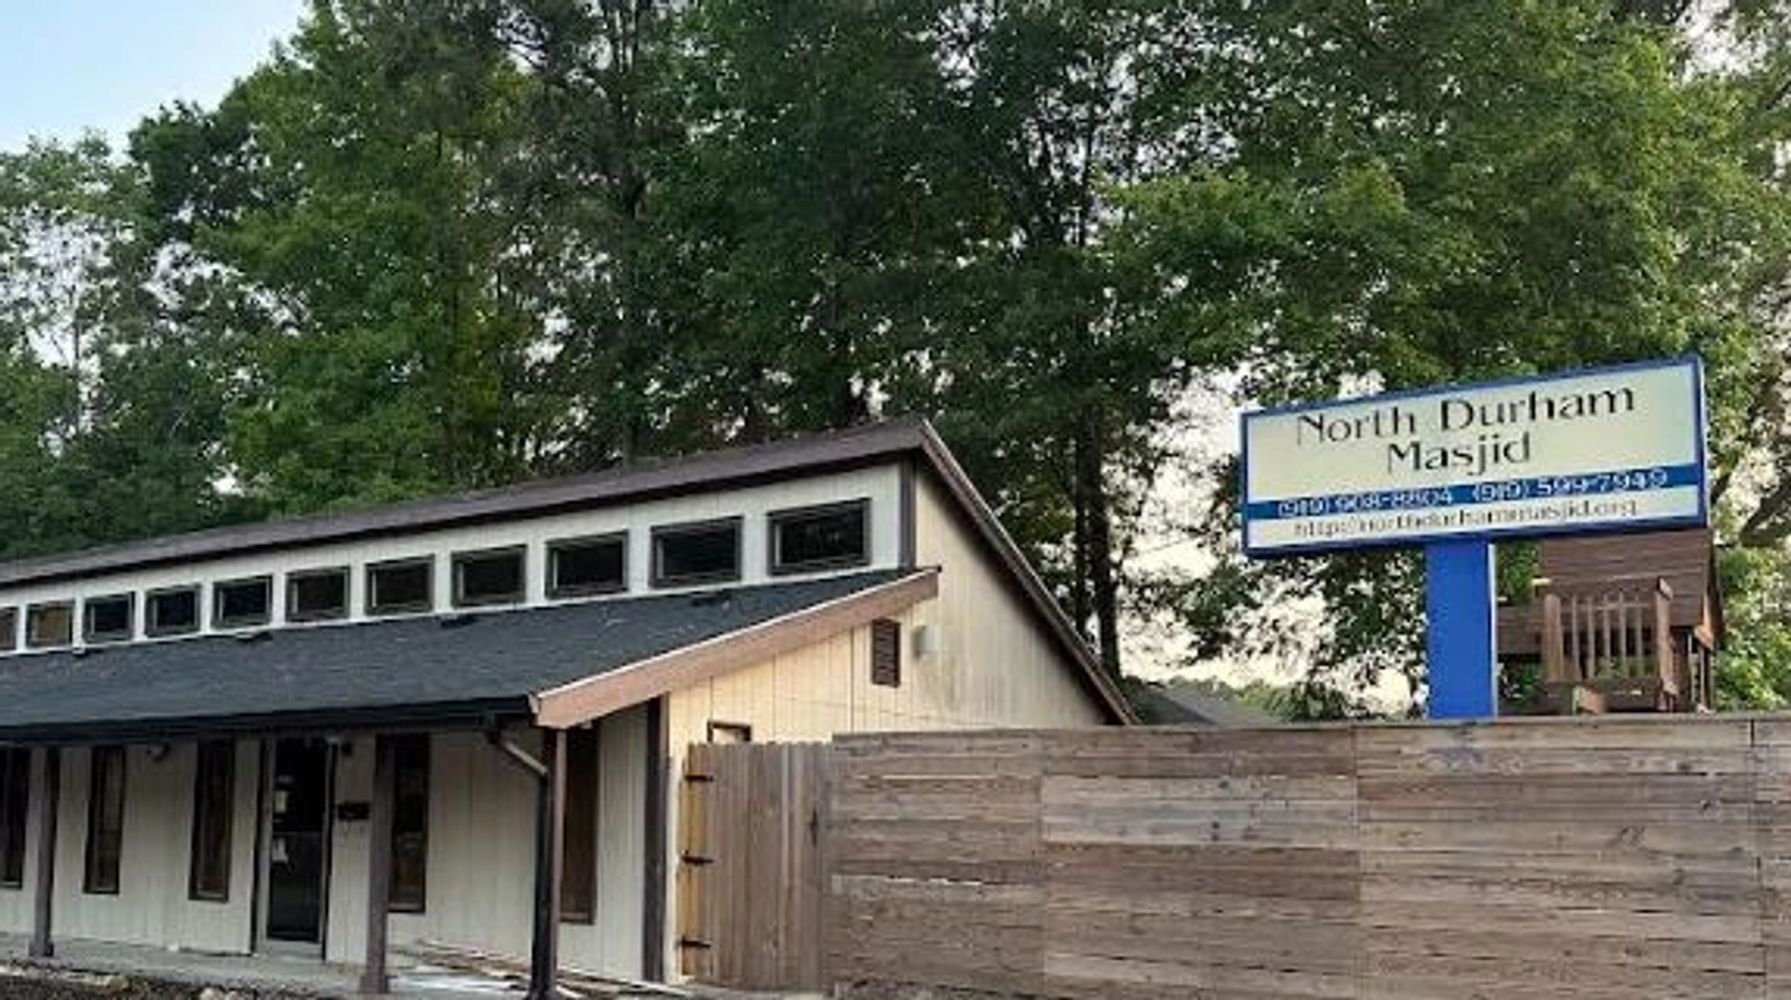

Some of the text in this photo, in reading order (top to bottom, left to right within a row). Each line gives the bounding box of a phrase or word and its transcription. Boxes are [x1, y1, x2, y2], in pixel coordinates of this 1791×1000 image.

[1297, 386, 1635, 445] North Durham
[1388, 432, 1531, 475] Masjid
